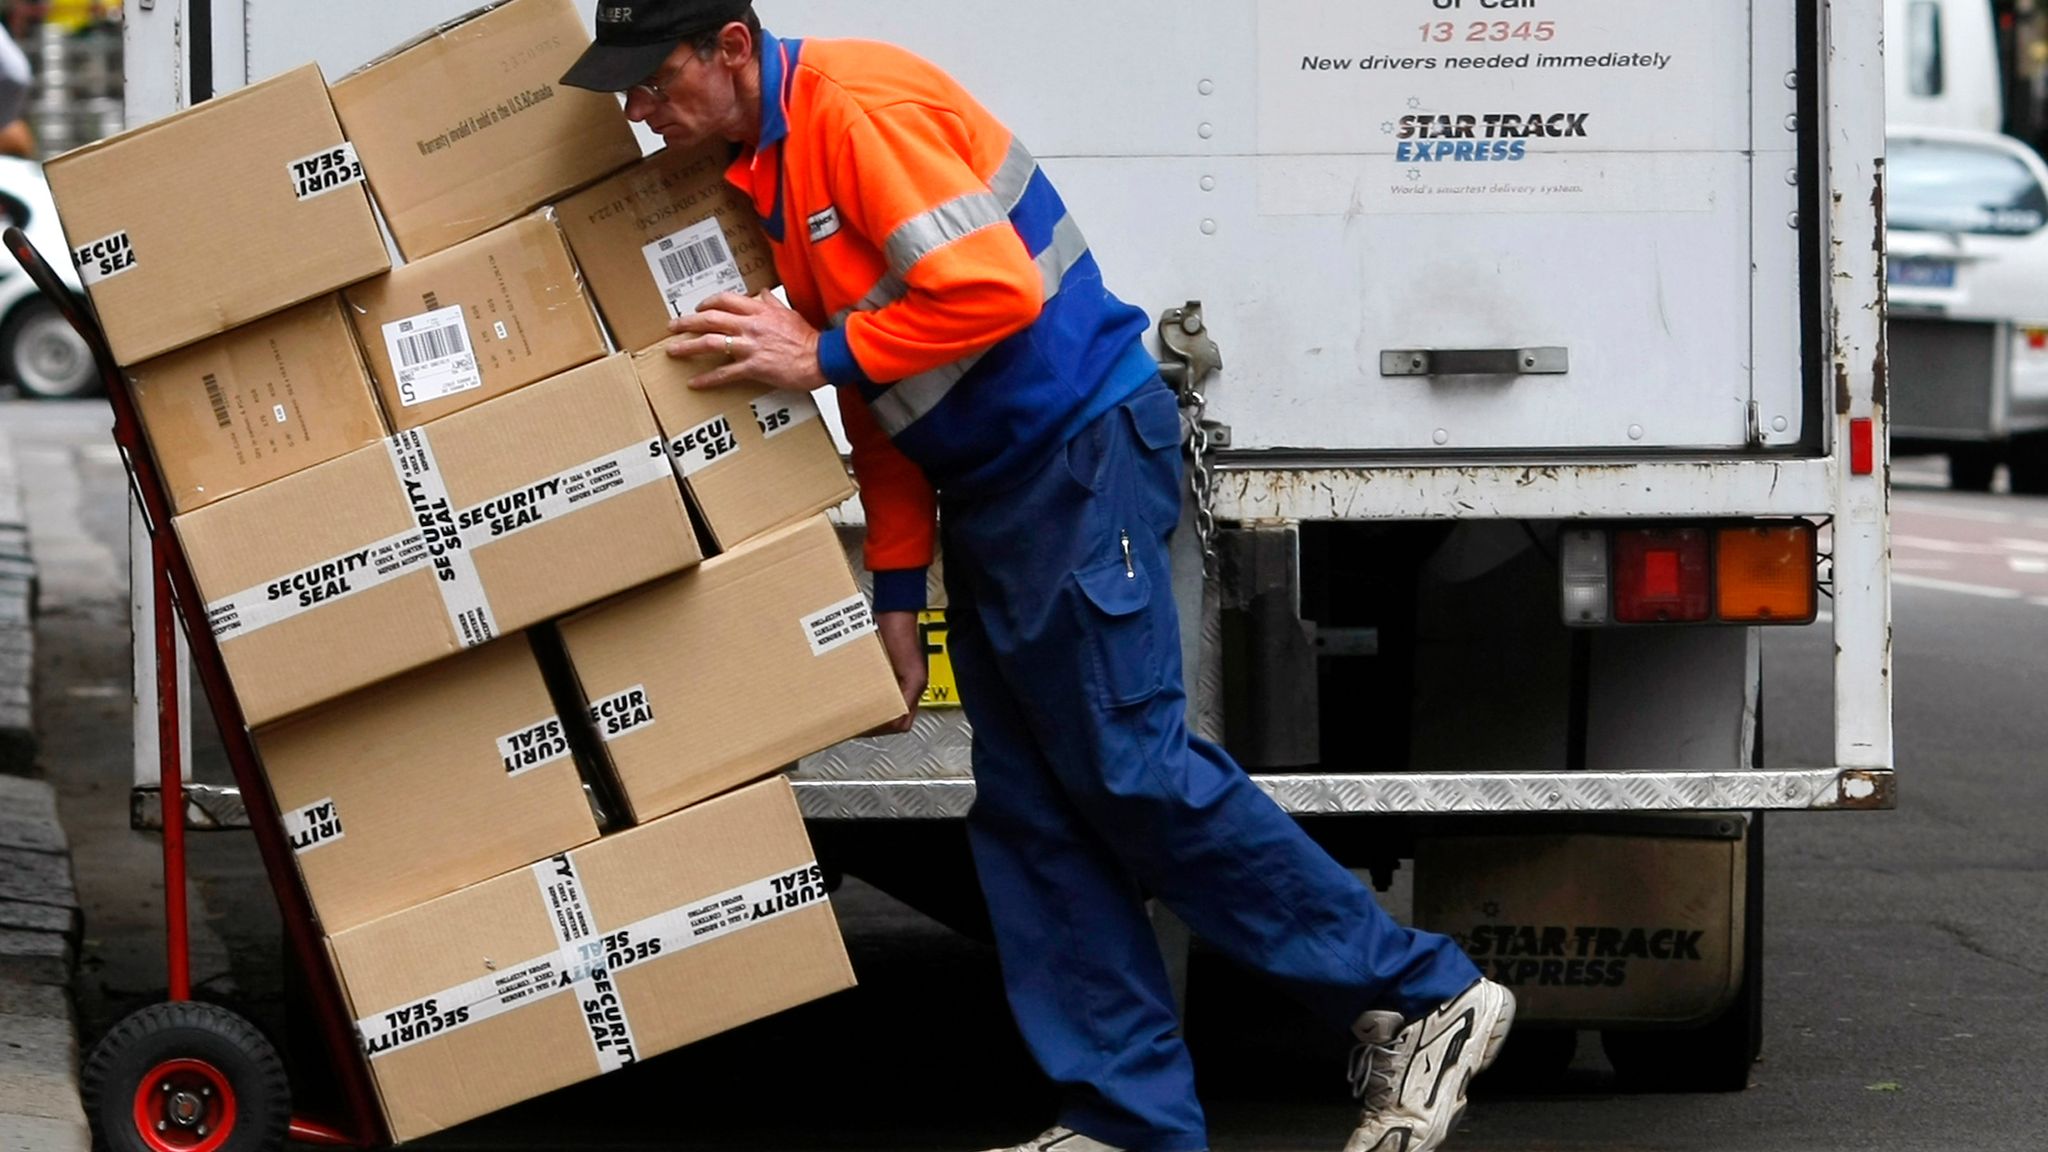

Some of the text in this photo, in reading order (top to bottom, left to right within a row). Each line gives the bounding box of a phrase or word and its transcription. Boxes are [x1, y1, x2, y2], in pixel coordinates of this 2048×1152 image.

[1417, 21, 1555, 42] 13 2345
[1301, 52, 1672, 70] New drivers needed immediately
[1396, 112, 1590, 139] STAR TRACK
[293, 149, 346, 178] SEAL
[1395, 140, 1527, 162] EXPRESS
[1435, 184, 1486, 195] smartest
[1489, 183, 1535, 197] delivery
[401, 383, 416, 402] 5
[458, 477, 561, 530] SECURITY
[403, 479, 456, 581] SECURITY
[431, 497, 462, 549] SEAL
[490, 506, 543, 536] SEAL
[267, 548, 370, 600] SECURITY
[299, 578, 351, 607] SEAL
[507, 720, 560, 752] SEAL
[770, 864, 823, 894] SEAL
[1470, 925, 1706, 961] STAR TRACK
[386, 998, 438, 1029] SEAL
[584, 999, 612, 1052] SEAL
[366, 1006, 470, 1055] SECURITY
